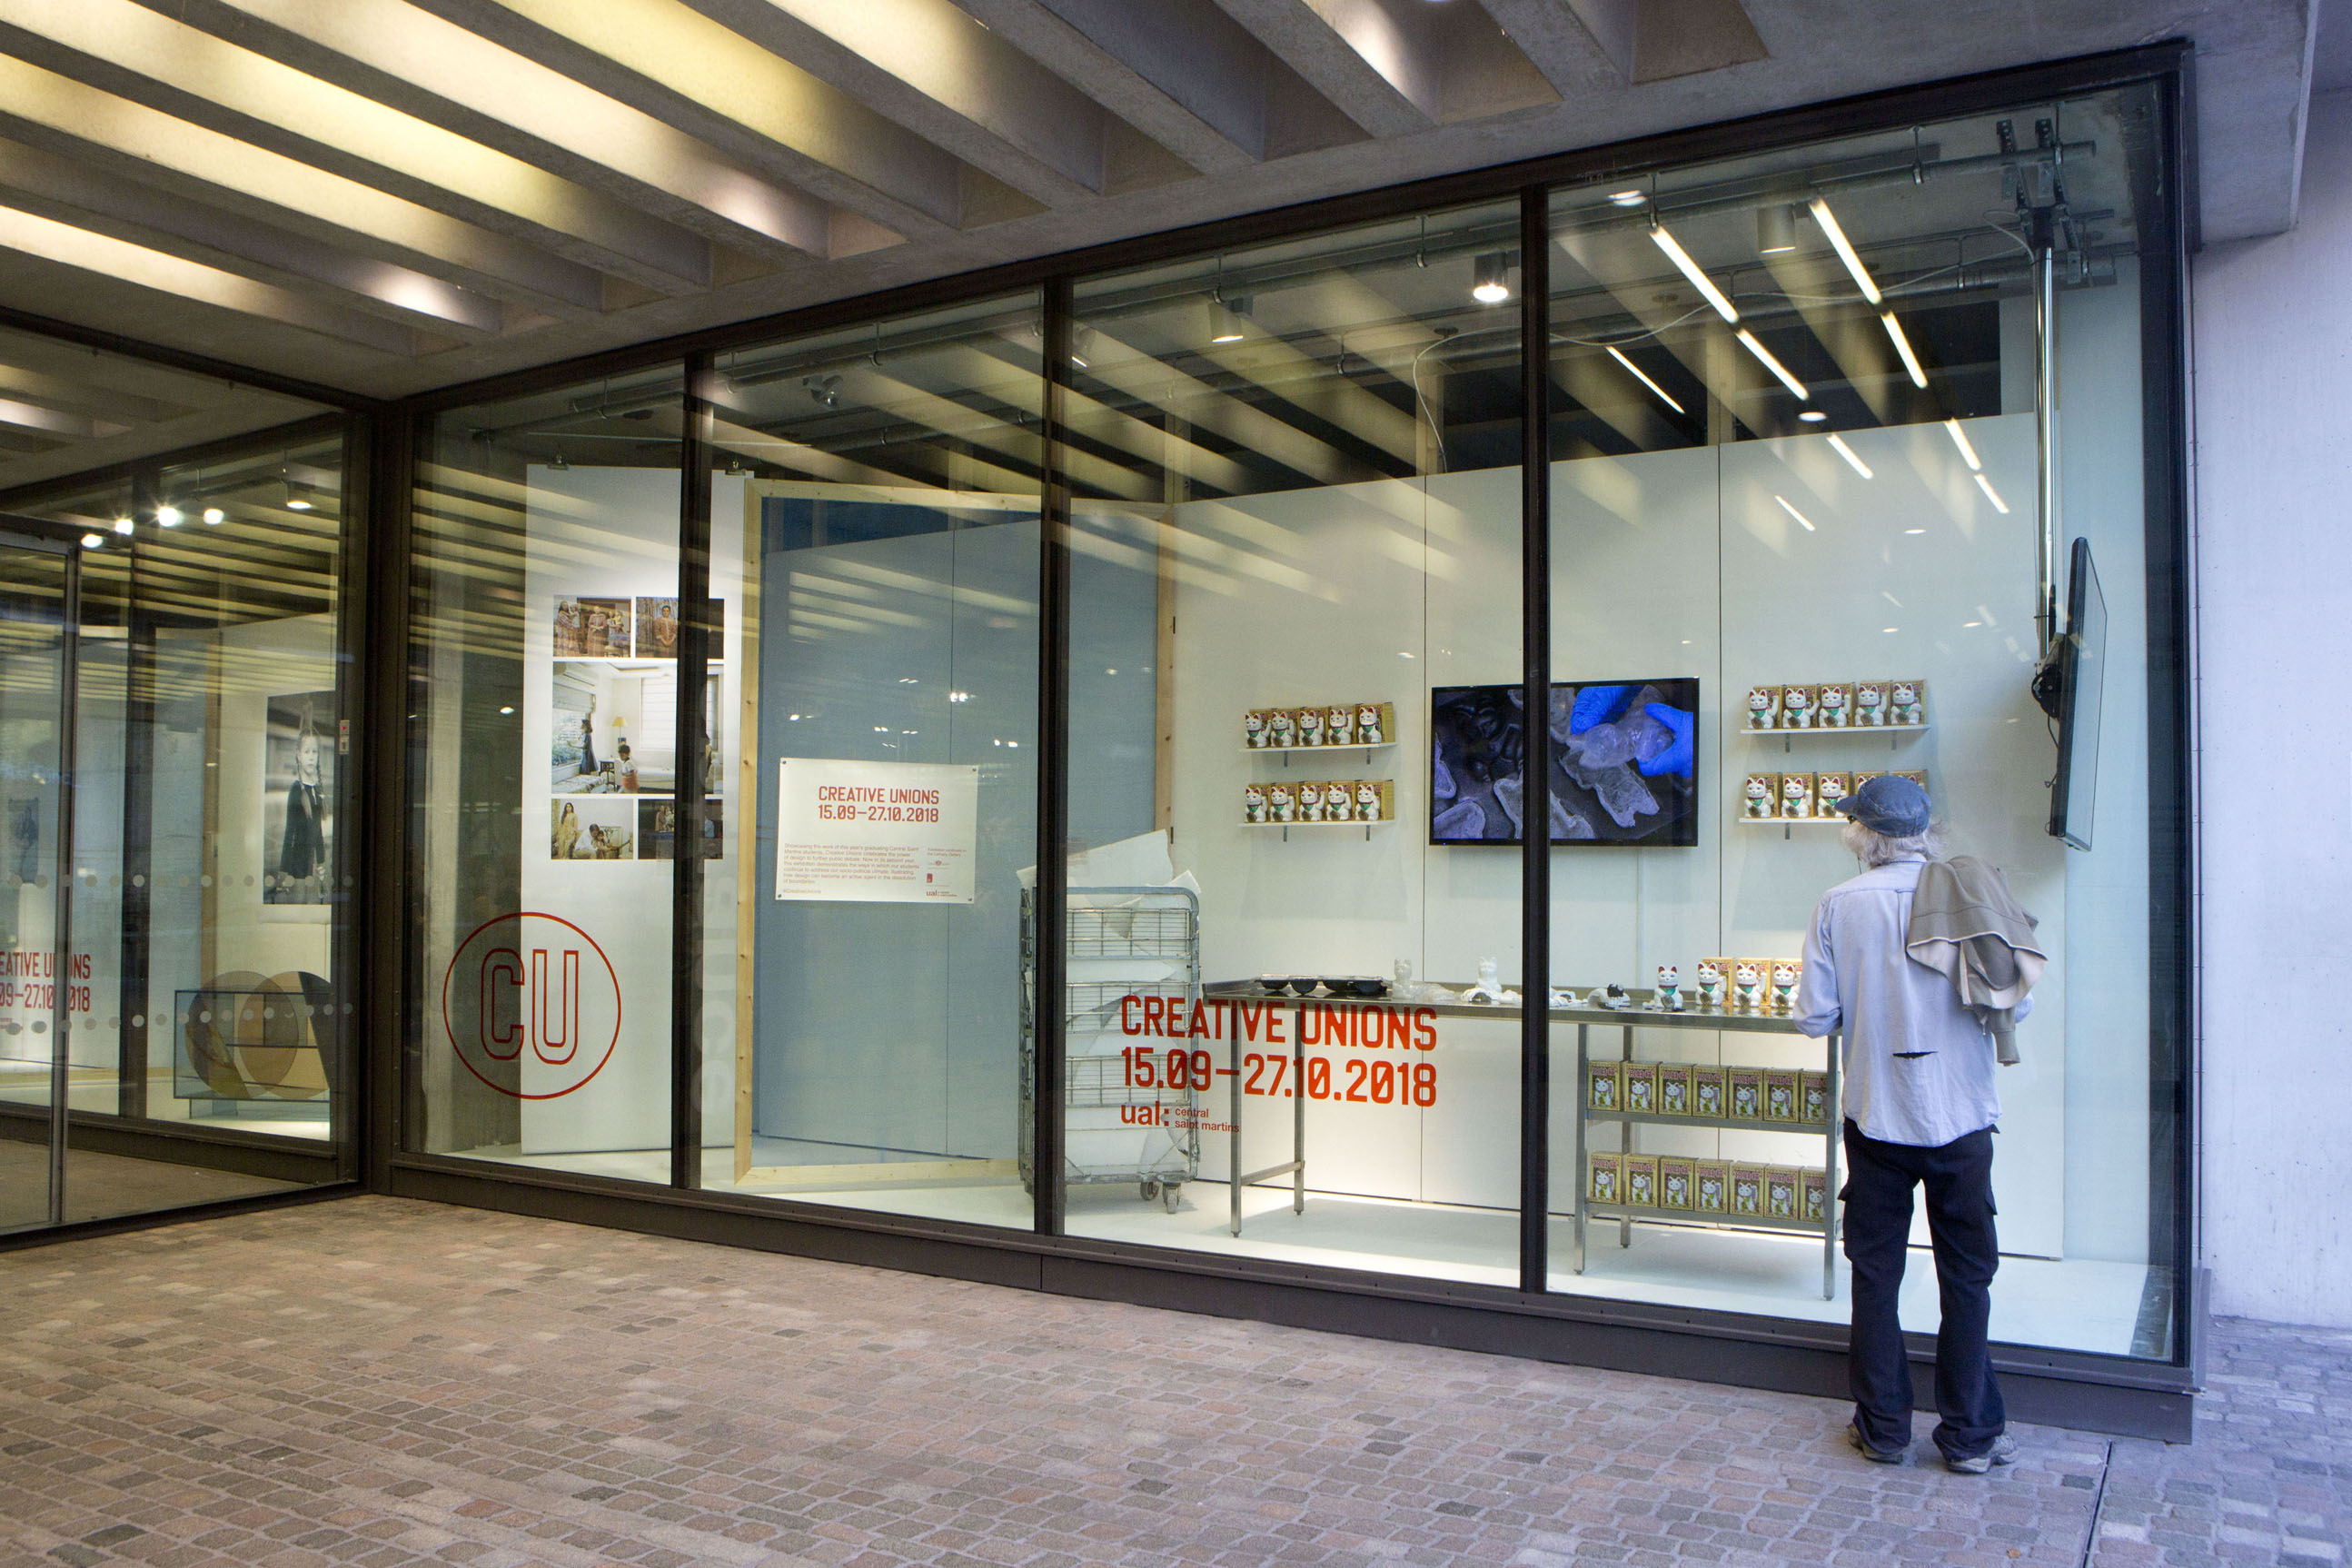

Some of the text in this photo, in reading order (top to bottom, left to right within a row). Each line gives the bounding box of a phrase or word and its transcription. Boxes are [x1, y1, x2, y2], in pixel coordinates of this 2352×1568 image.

[819, 786, 939, 805] CREATIVE UNIONS
[44, 952, 91, 979] UNS
[481, 948, 579, 1065] CU
[1121, 995, 1437, 1052] CREATIVE UNIONS
[1120, 1100, 1169, 1126] ual:
[1175, 1108, 1209, 1118] central
[1175, 1119, 1240, 1133] saint martins
